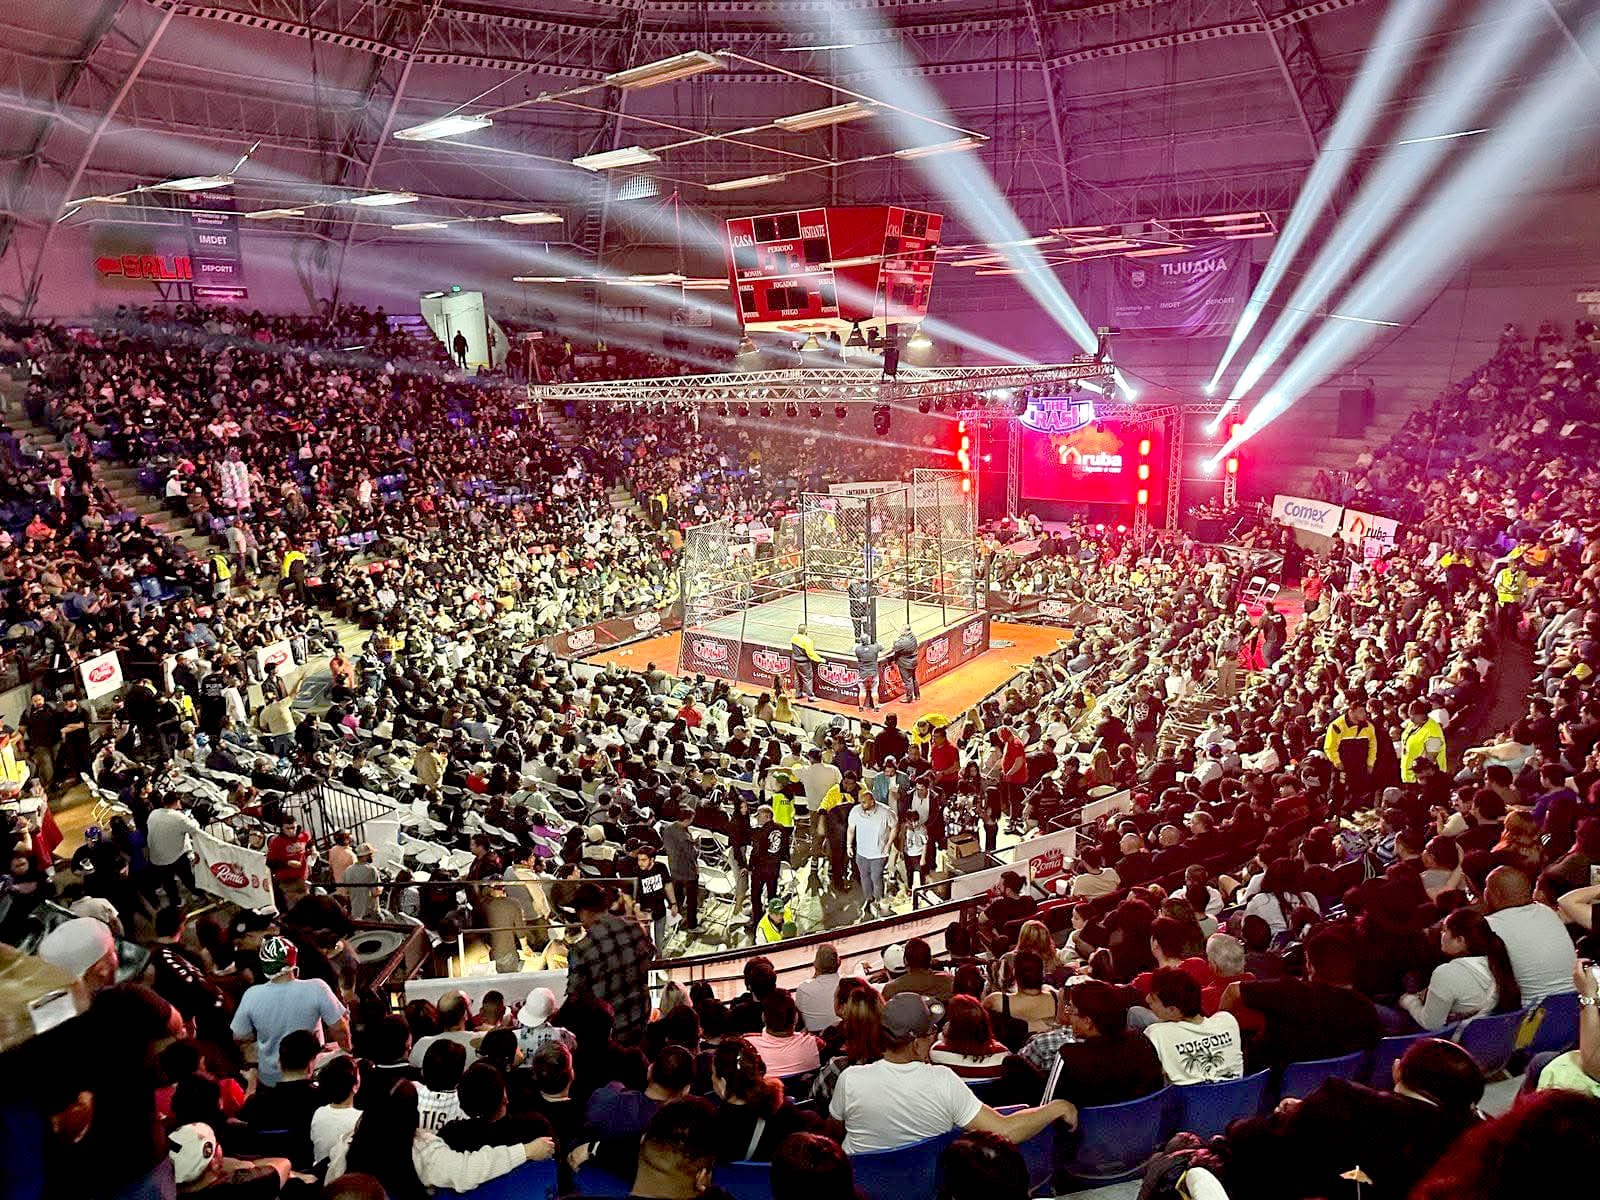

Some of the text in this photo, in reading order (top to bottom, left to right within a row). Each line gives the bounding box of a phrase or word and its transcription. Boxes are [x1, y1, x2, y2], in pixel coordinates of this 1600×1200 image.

[199, 235, 227, 245] IMDET
[733, 234, 754, 247] CASA
[201, 264, 233, 273] DEPORTE
[1161, 258, 1227, 275] TIJUANA
[1045, 401, 1067, 411] THE
[1284, 501, 1332, 523] Comex
[820, 664, 857, 683] CRASH
[216, 863, 244, 885] Roma
[1030, 858, 1061, 875] Roma
